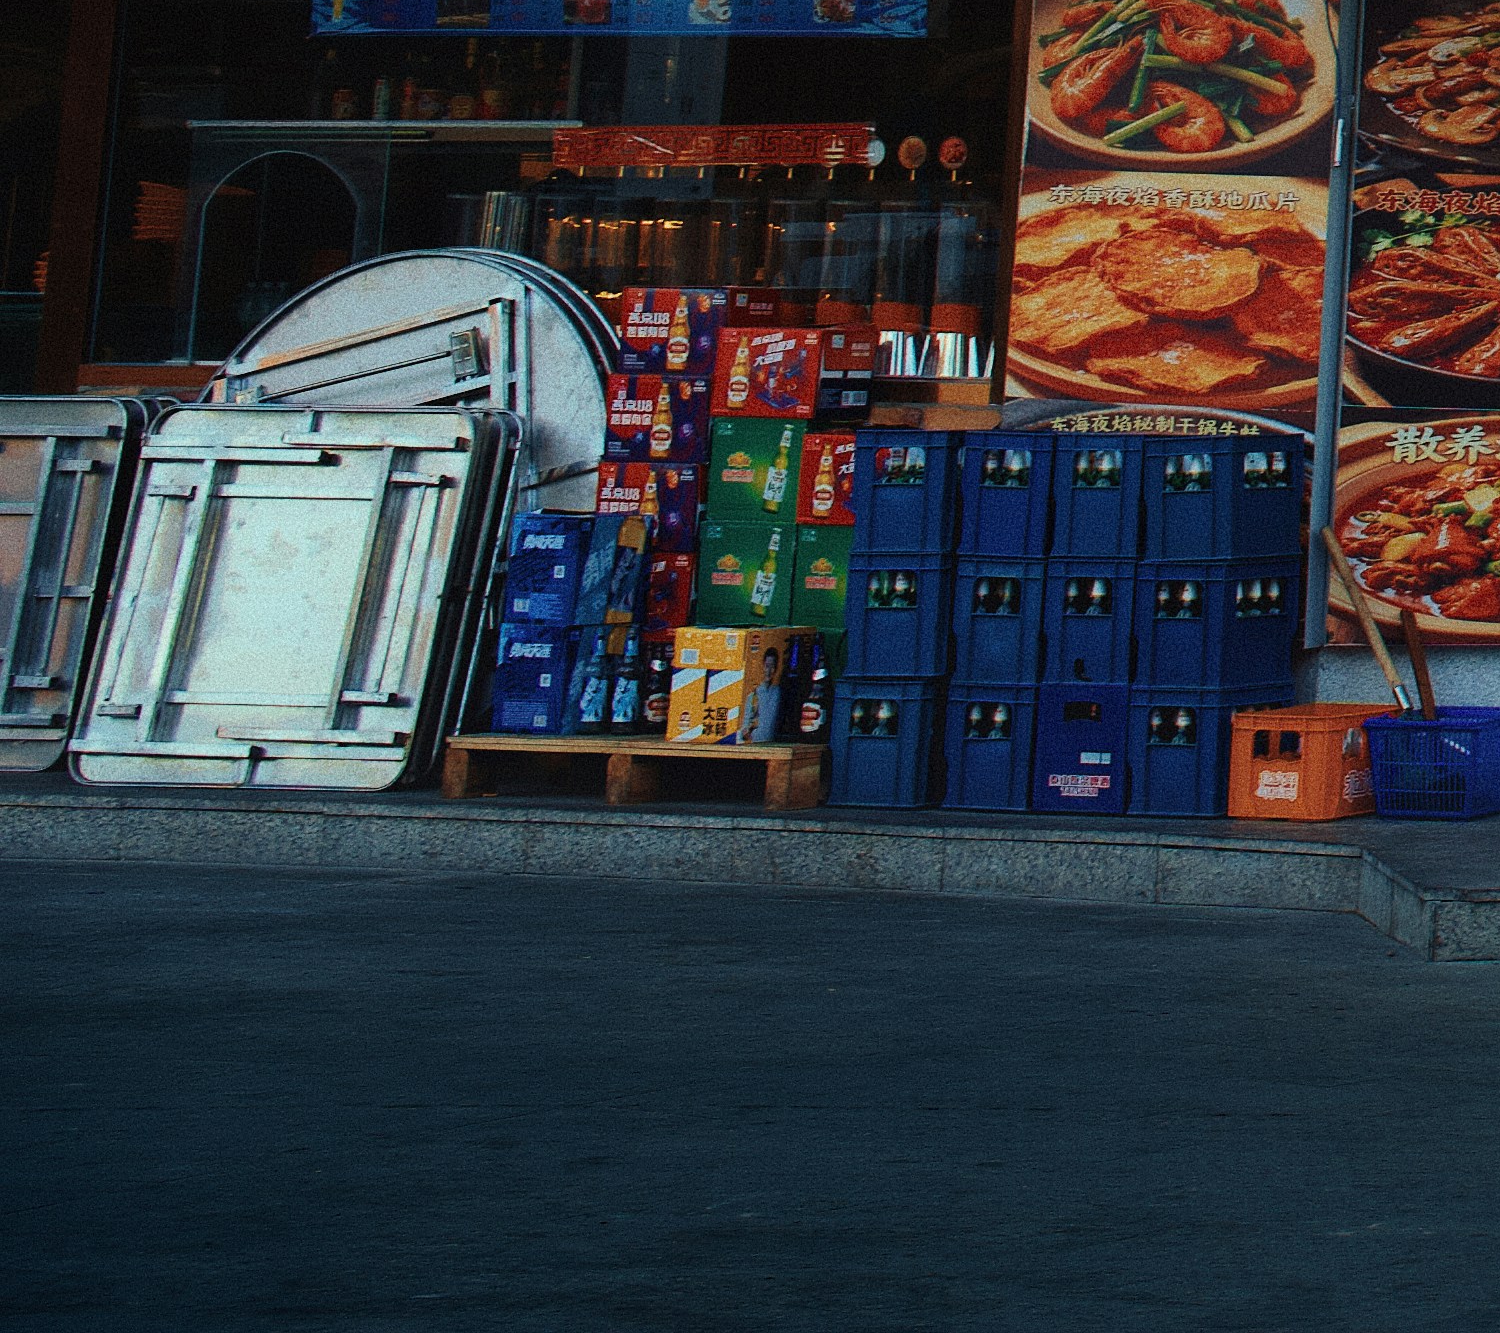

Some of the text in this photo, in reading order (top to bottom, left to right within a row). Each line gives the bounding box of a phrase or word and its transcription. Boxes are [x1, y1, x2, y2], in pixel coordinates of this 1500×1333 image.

[1049, 183, 1300, 213] 东海夜焰香酥地瓜片
